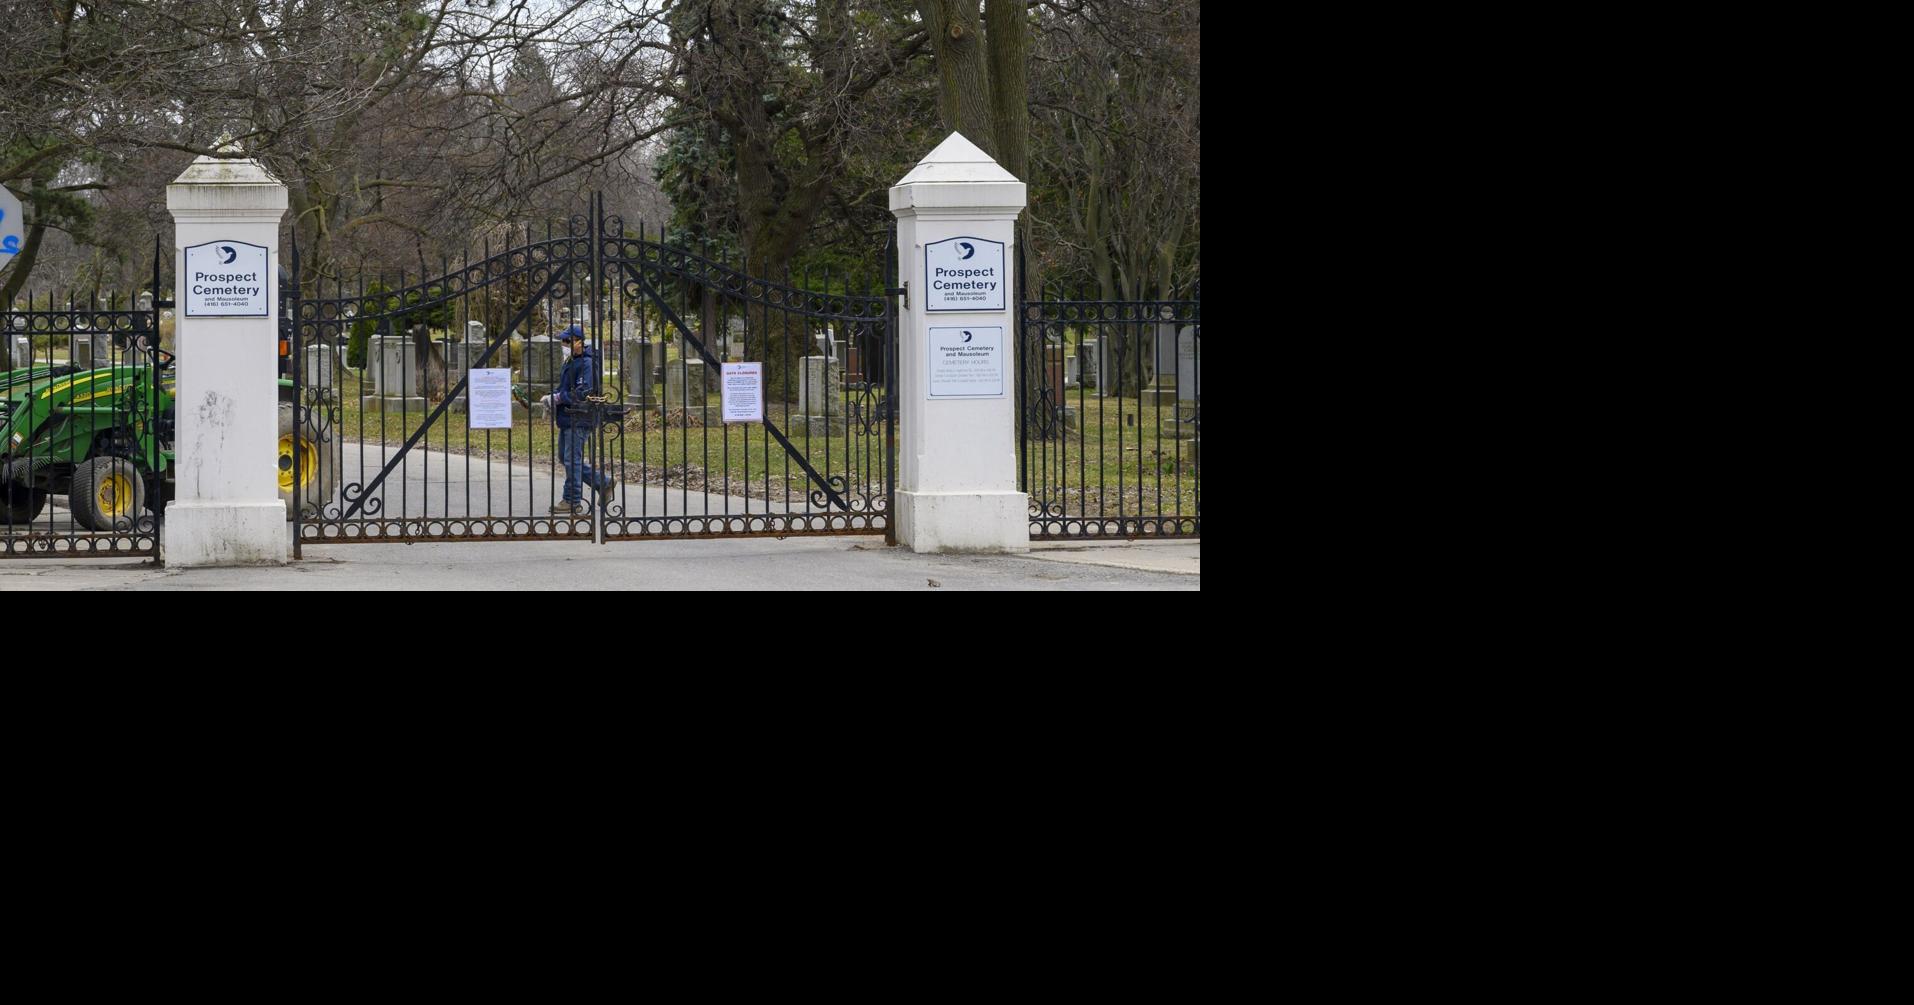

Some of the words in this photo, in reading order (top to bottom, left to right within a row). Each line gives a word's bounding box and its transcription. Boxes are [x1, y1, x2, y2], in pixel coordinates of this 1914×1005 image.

[195, 272, 256, 284] Prospect
[936, 268, 994, 278] Prospect
[193, 285, 260, 296] Cemetery
[933, 280, 997, 291] Cemetery
